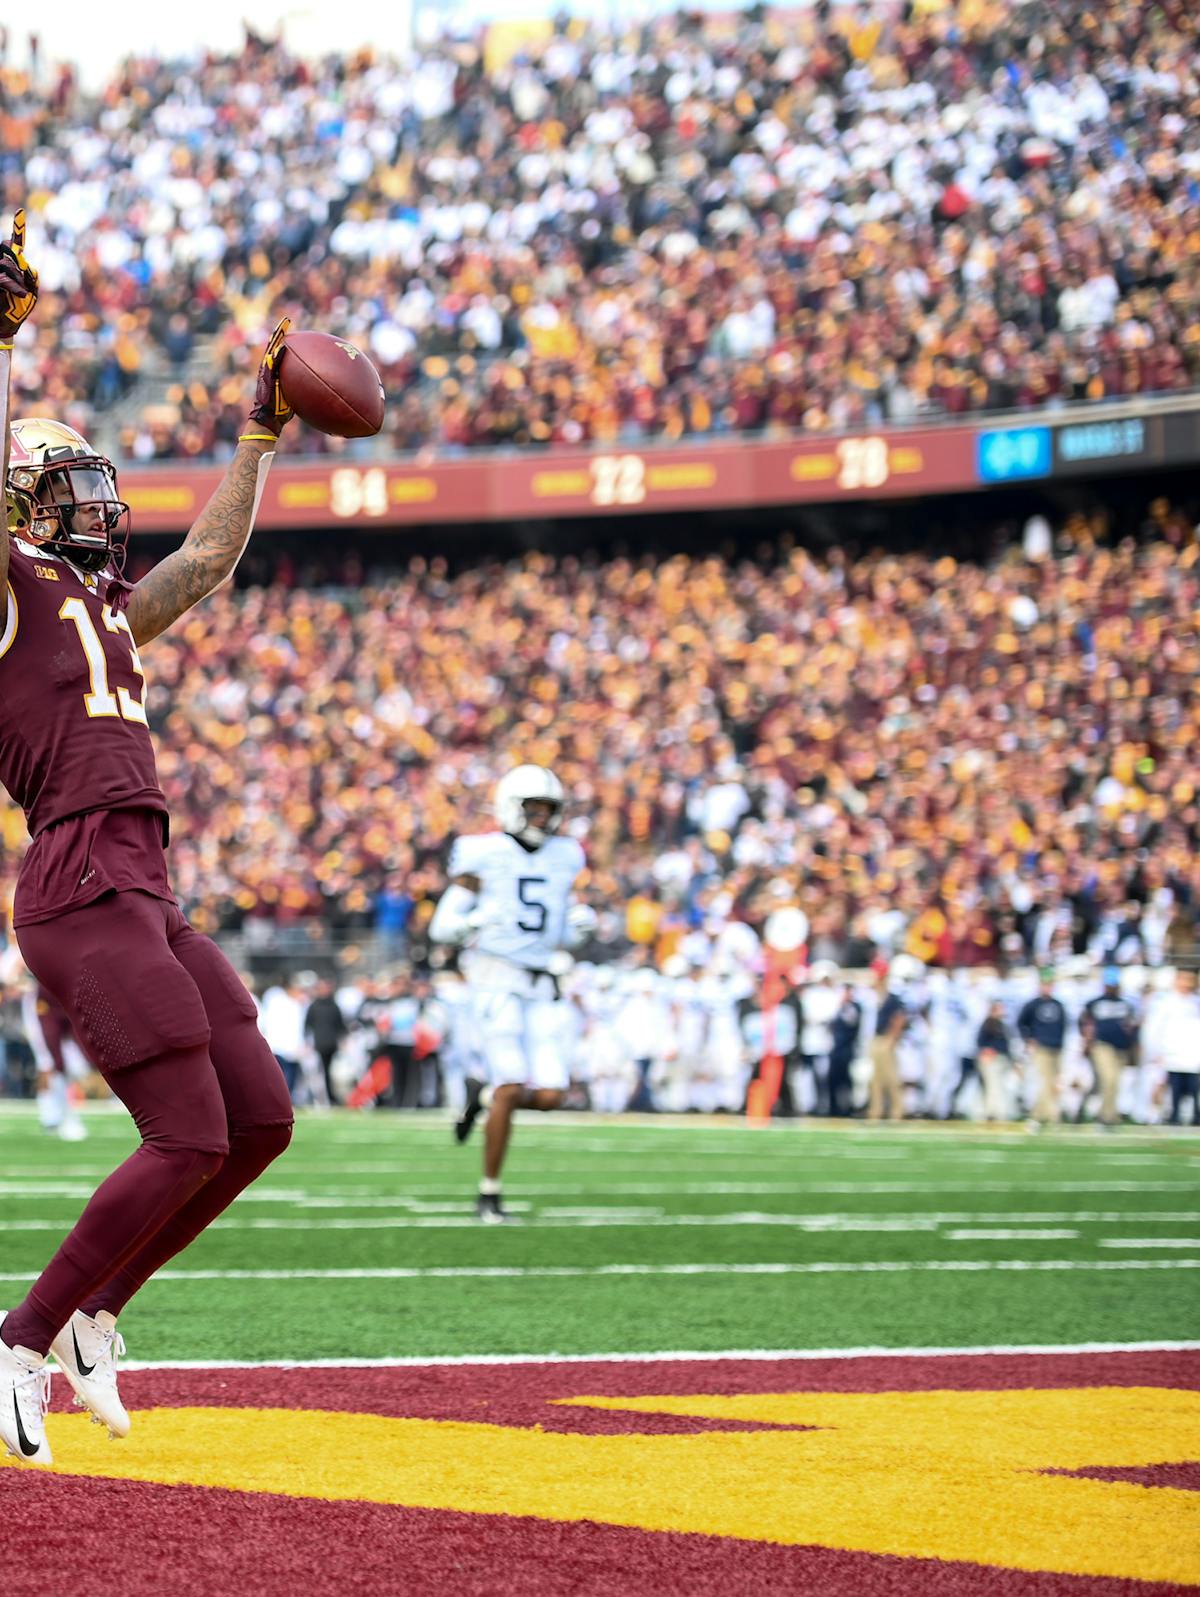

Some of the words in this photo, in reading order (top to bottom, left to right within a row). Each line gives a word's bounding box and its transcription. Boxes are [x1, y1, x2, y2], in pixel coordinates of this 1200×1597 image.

[591, 455, 645, 505] 72
[58, 597, 149, 729] 13
[517, 878, 547, 931] 5
